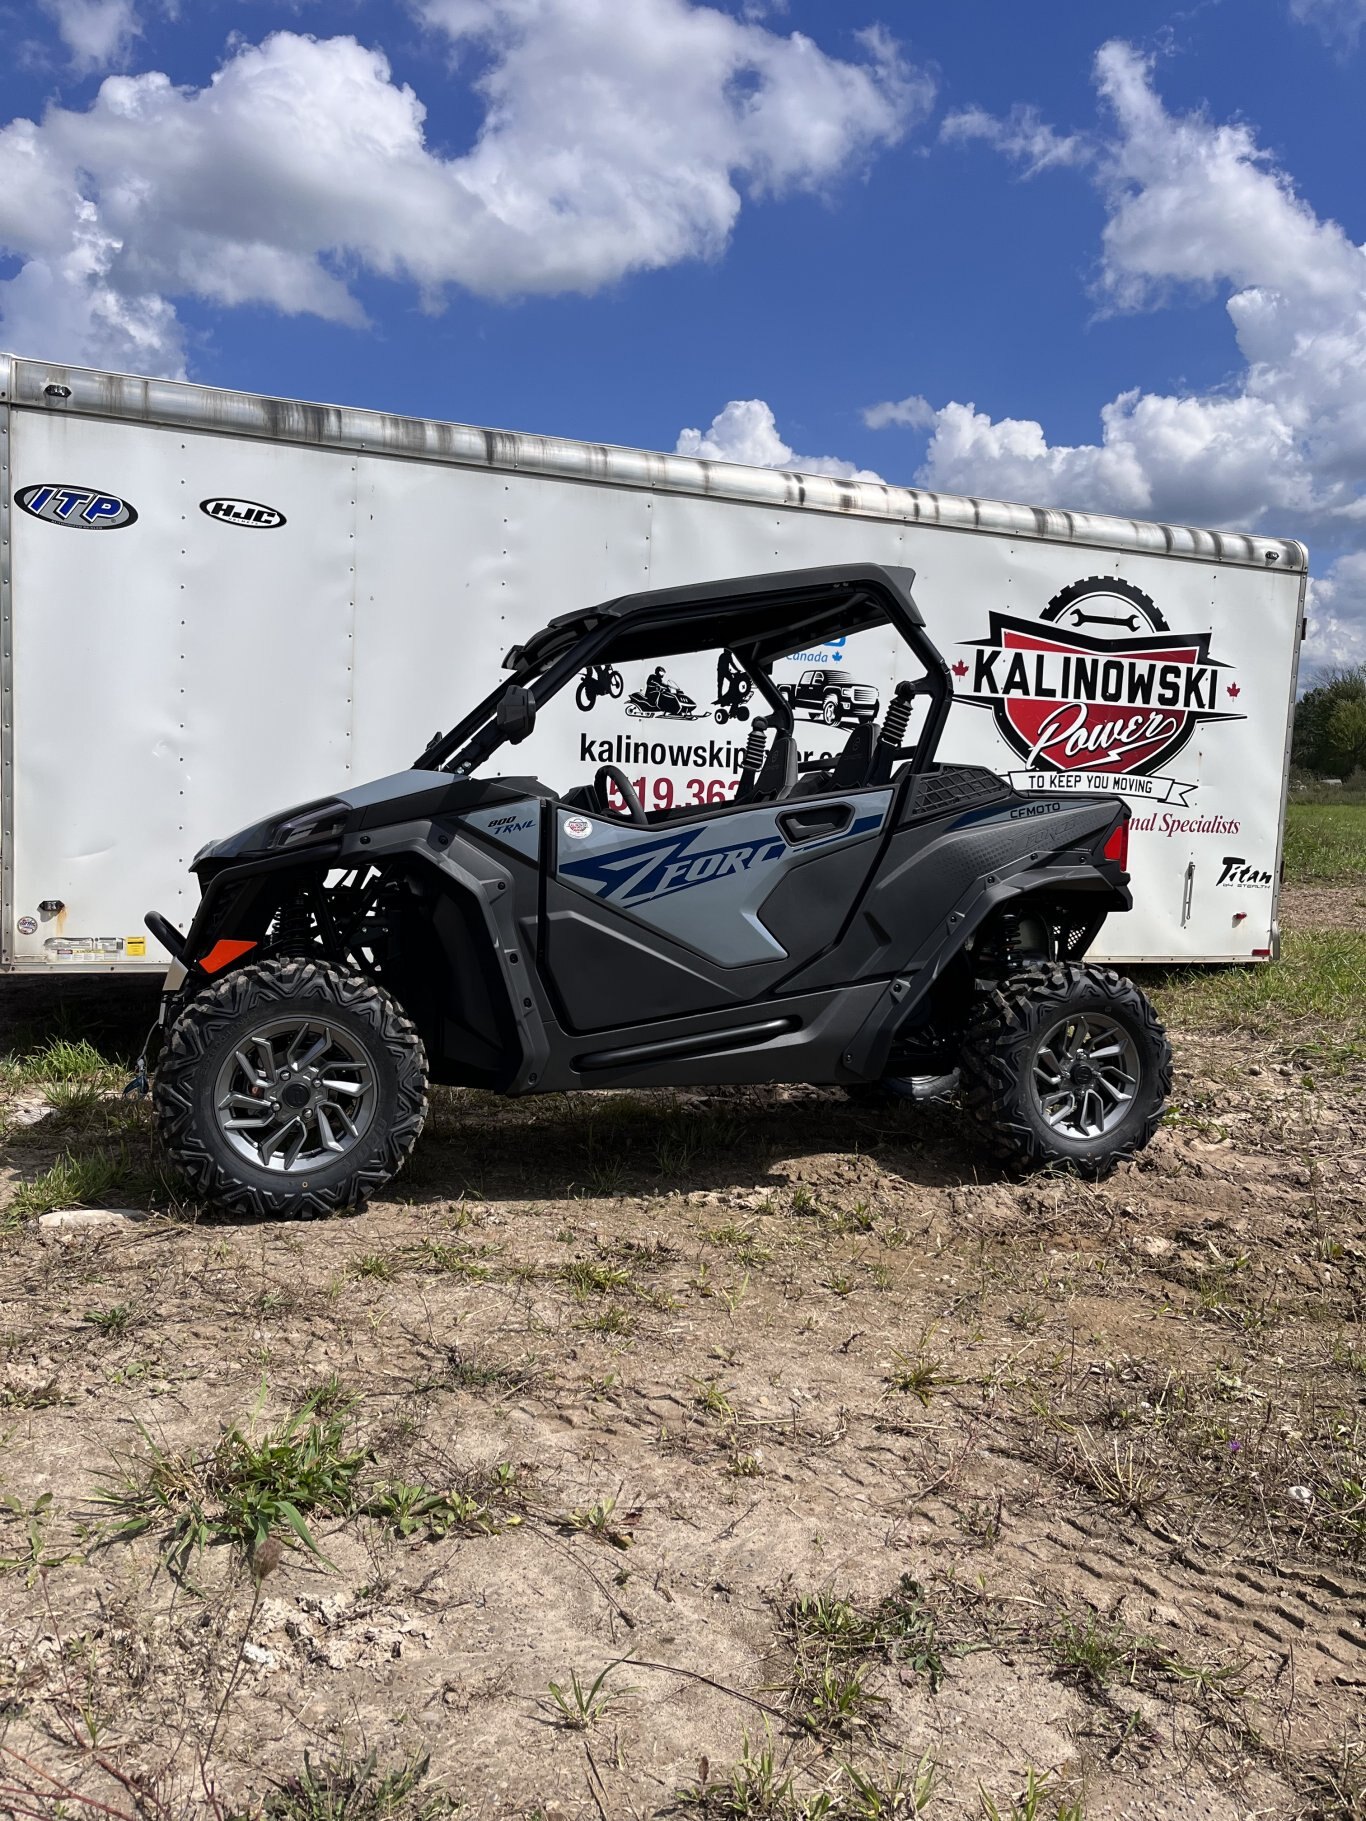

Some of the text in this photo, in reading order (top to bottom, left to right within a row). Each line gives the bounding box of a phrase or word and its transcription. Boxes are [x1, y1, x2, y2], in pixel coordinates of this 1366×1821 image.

[27, 486, 124, 524] ITP
[209, 502, 277, 525] HJC
[973, 648, 1218, 710] KALINOWSKI
[1025, 701, 1176, 771] Power
[1028, 774, 1153, 794] TO KEEP YOU MOVING
[487, 815, 517, 828] 800
[1010, 802, 1061, 819] CFMOTO
[494, 819, 537, 835] TRAIL
[1158, 812, 1241, 838] Specialists
[1215, 856, 1273, 887] Titan
